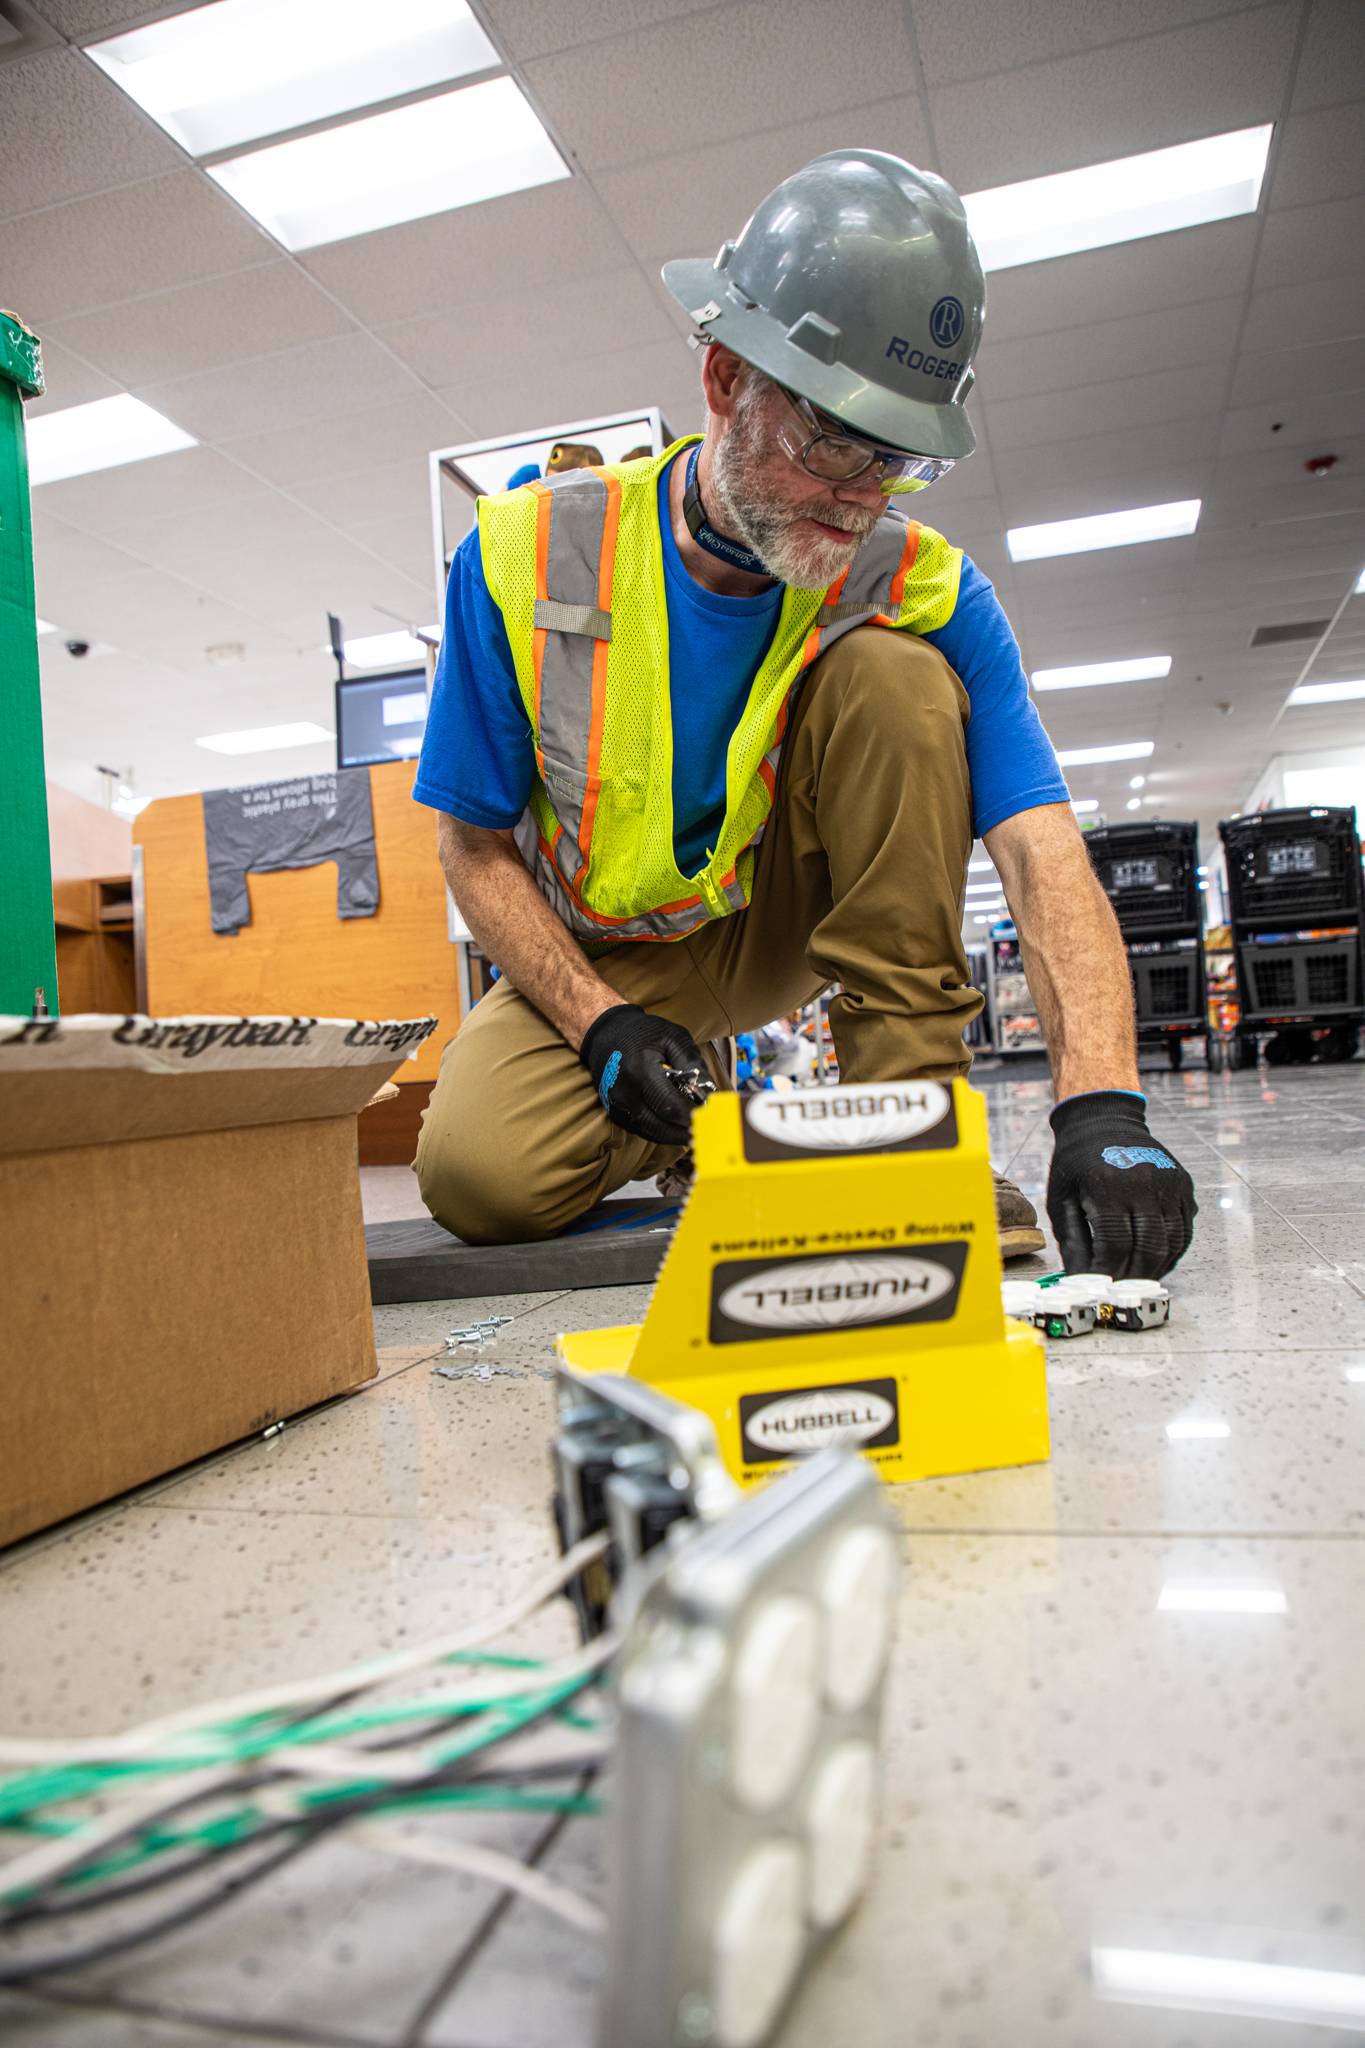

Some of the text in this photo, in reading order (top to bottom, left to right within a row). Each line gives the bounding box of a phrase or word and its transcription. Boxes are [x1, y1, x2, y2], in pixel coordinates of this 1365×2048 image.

[720, 544, 755, 566] Kansas
[765, 1092, 929, 1122] HUBBELL
[904, 1220, 976, 1238] Wiring
[742, 1274, 931, 1309] HUBBELL
[762, 1407, 881, 1436] HUBBELL
